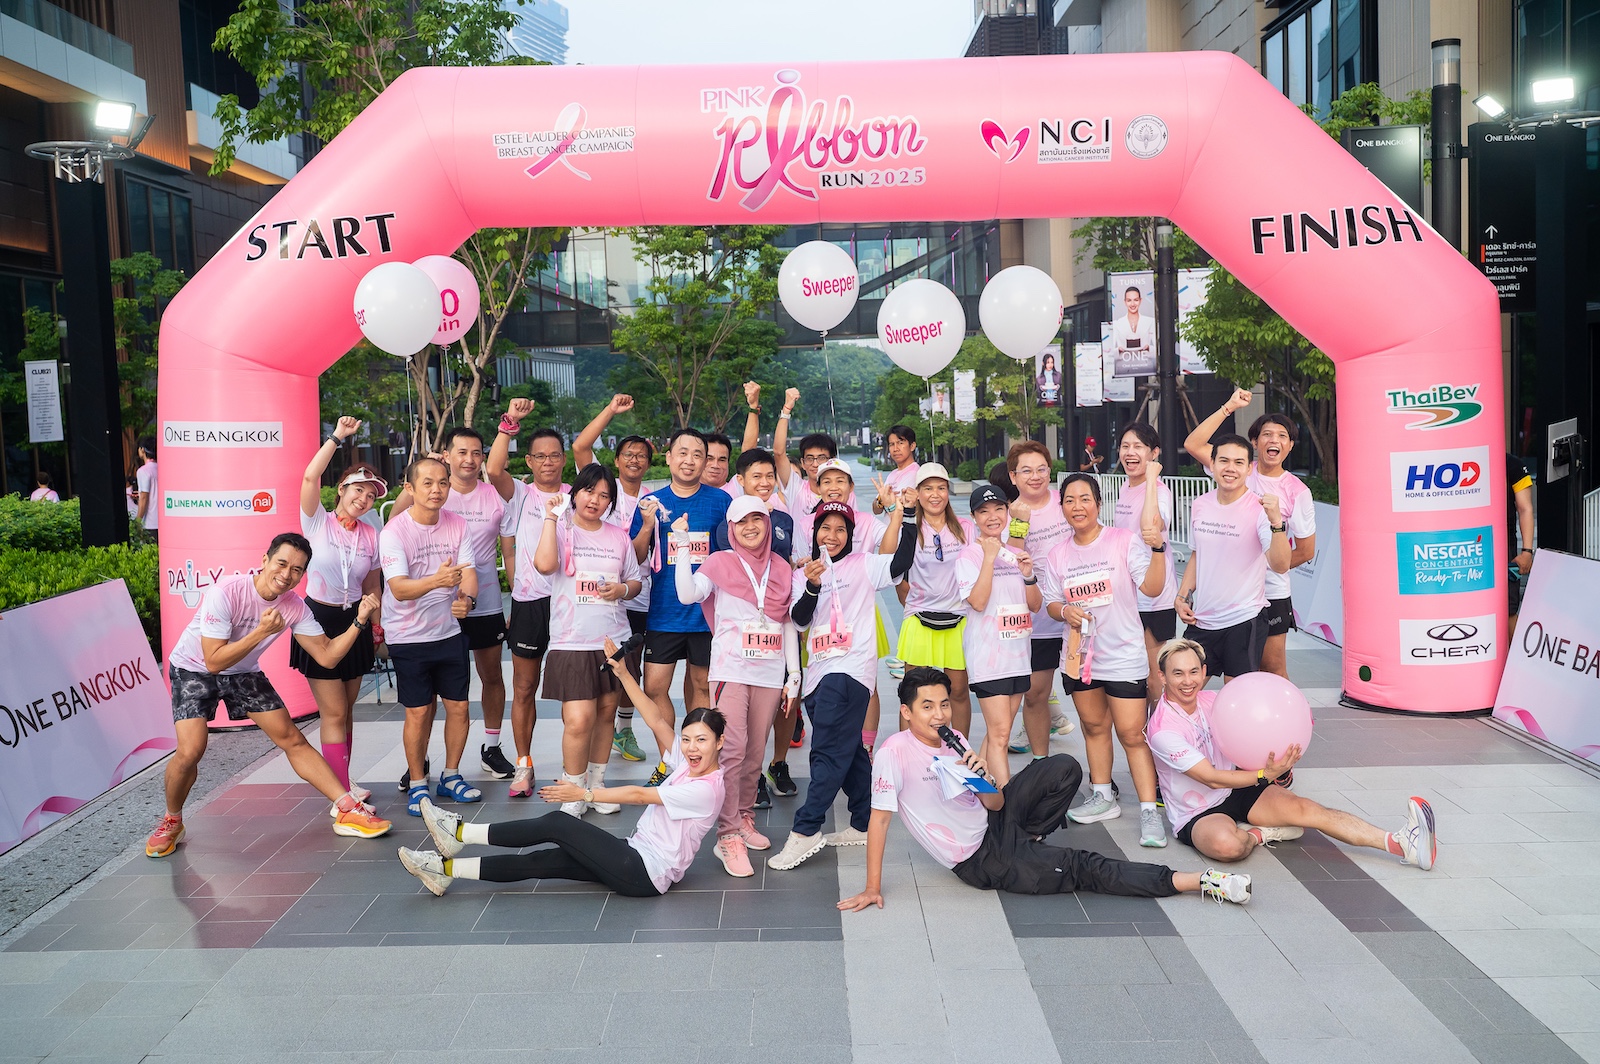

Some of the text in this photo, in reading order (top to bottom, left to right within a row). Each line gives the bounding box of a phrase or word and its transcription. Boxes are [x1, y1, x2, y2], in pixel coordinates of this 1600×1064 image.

[703, 90, 763, 108] PINK
[494, 127, 635, 145] ESTEE LAUDER COMPANIES
[1041, 119, 1110, 144] NCI
[1484, 134, 1503, 143] ONE
[498, 140, 633, 158] BREAST CANCER CAMPAIGN
[709, 70, 927, 211] Ribbon
[1355, 138, 1413, 148] ONE BANGKO
[1039, 147, 1110, 157] สถาบันมะเร็งแห่งชาติ
[822, 170, 925, 187] RUN 2025
[246, 213, 395, 261] START
[1251, 205, 1424, 254] FINISH
[802, 275, 855, 297] Sweeper
[1119, 277, 1146, 286] TURNS
[885, 320, 943, 345] Sweeper
[1121, 351, 1149, 362] ONE
[1041, 391, 1057, 399] ONE
[1388, 386, 1477, 407] ThaiBev
[165, 426, 280, 443] ONE BANGKOK
[1405, 461, 1481, 490] HOD
[1455, 488, 1481, 496] DELIVERY
[823, 502, 848, 513] QATAR
[669, 542, 708, 555] M085
[1413, 535, 1483, 561] NESCAFÉ
[1415, 557, 1483, 568] CONCENTRATE
[1069, 581, 1107, 599] F0038
[748, 633, 781, 646] F1400
[1001, 631, 1011, 639] 10
[1411, 642, 1492, 658] CHERY
[1523, 621, 1571, 667] ONE
[745, 649, 755, 658] 10
[0, 657, 151, 748] ONE BANGKOK
